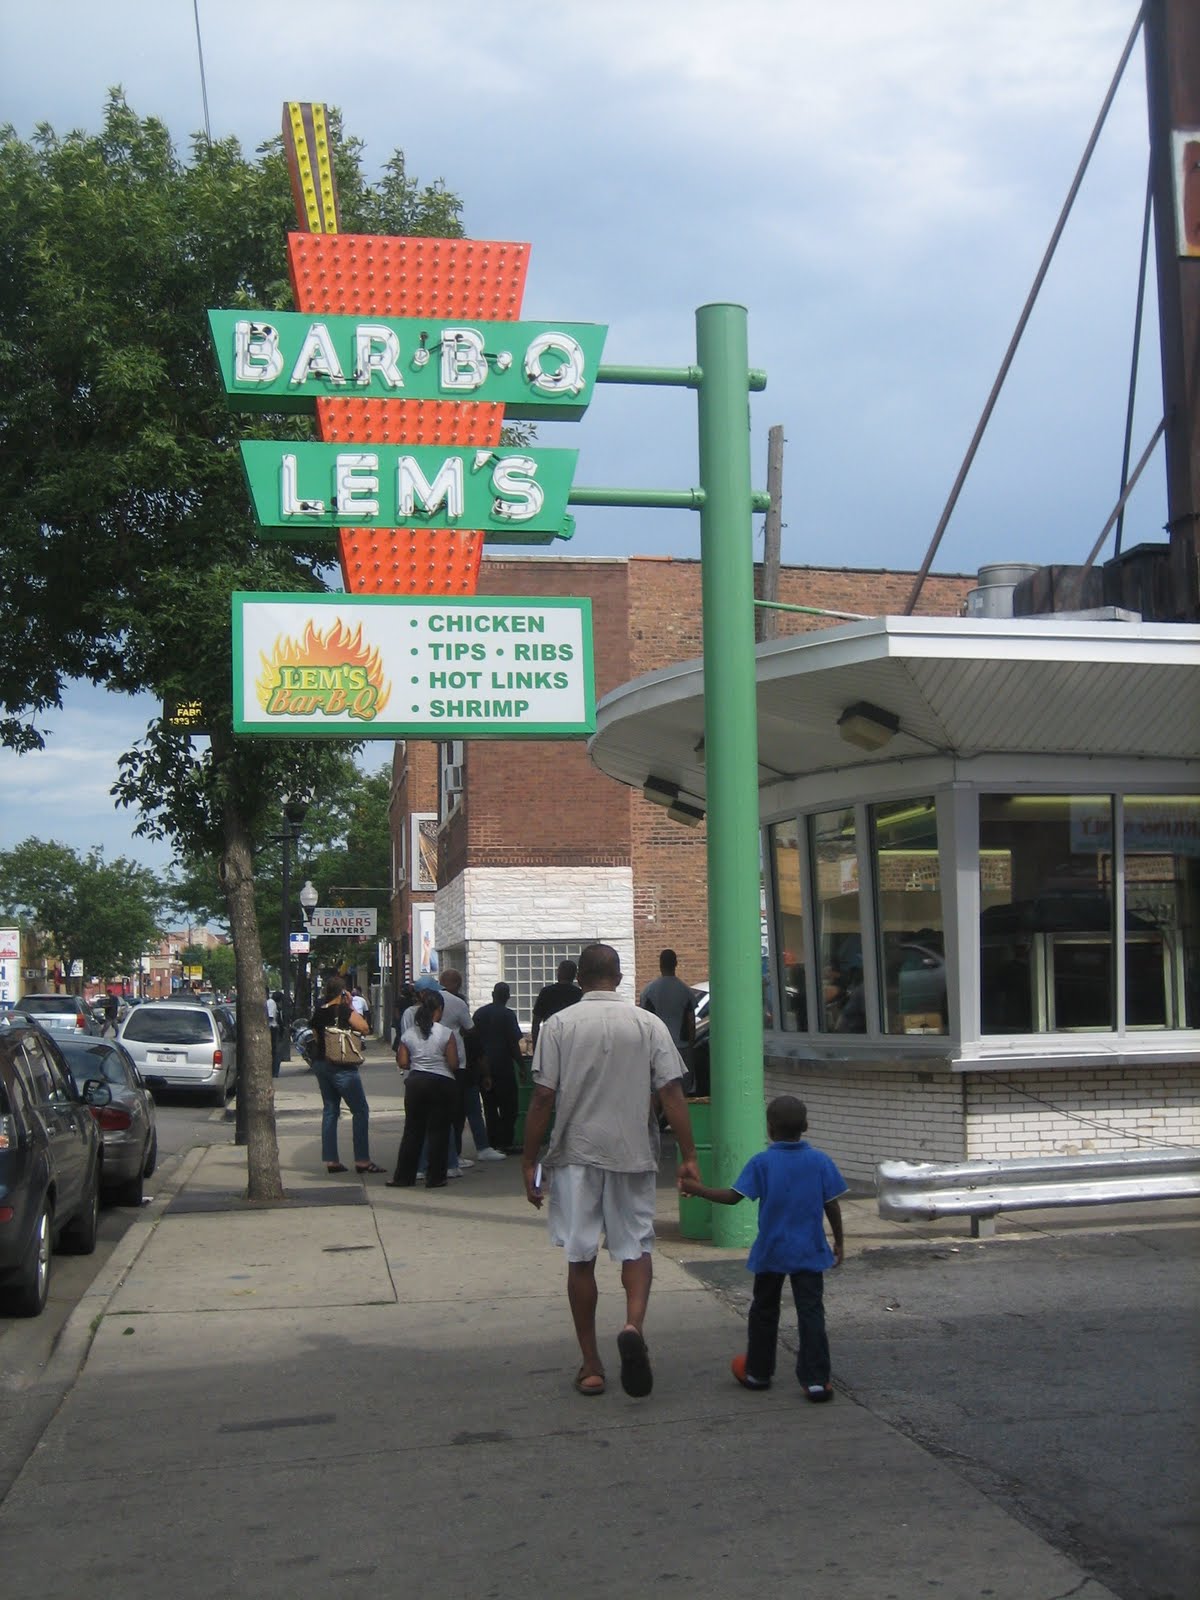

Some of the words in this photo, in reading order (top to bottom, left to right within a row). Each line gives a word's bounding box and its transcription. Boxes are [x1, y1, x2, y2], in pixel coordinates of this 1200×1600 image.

[281, 450, 545, 520] LEM'S
[428, 614, 545, 633] CHICKEN
[428, 643, 486, 661] TIPS
[514, 643, 574, 661] RIBS
[281, 668, 368, 690] LEM'S
[429, 671, 483, 689] HOT
[491, 671, 569, 690] LINKS
[269, 689, 377, 720] Bar-B-Q
[429, 699, 530, 718] SHRIMP
[310, 917, 371, 927] CLEANERS
